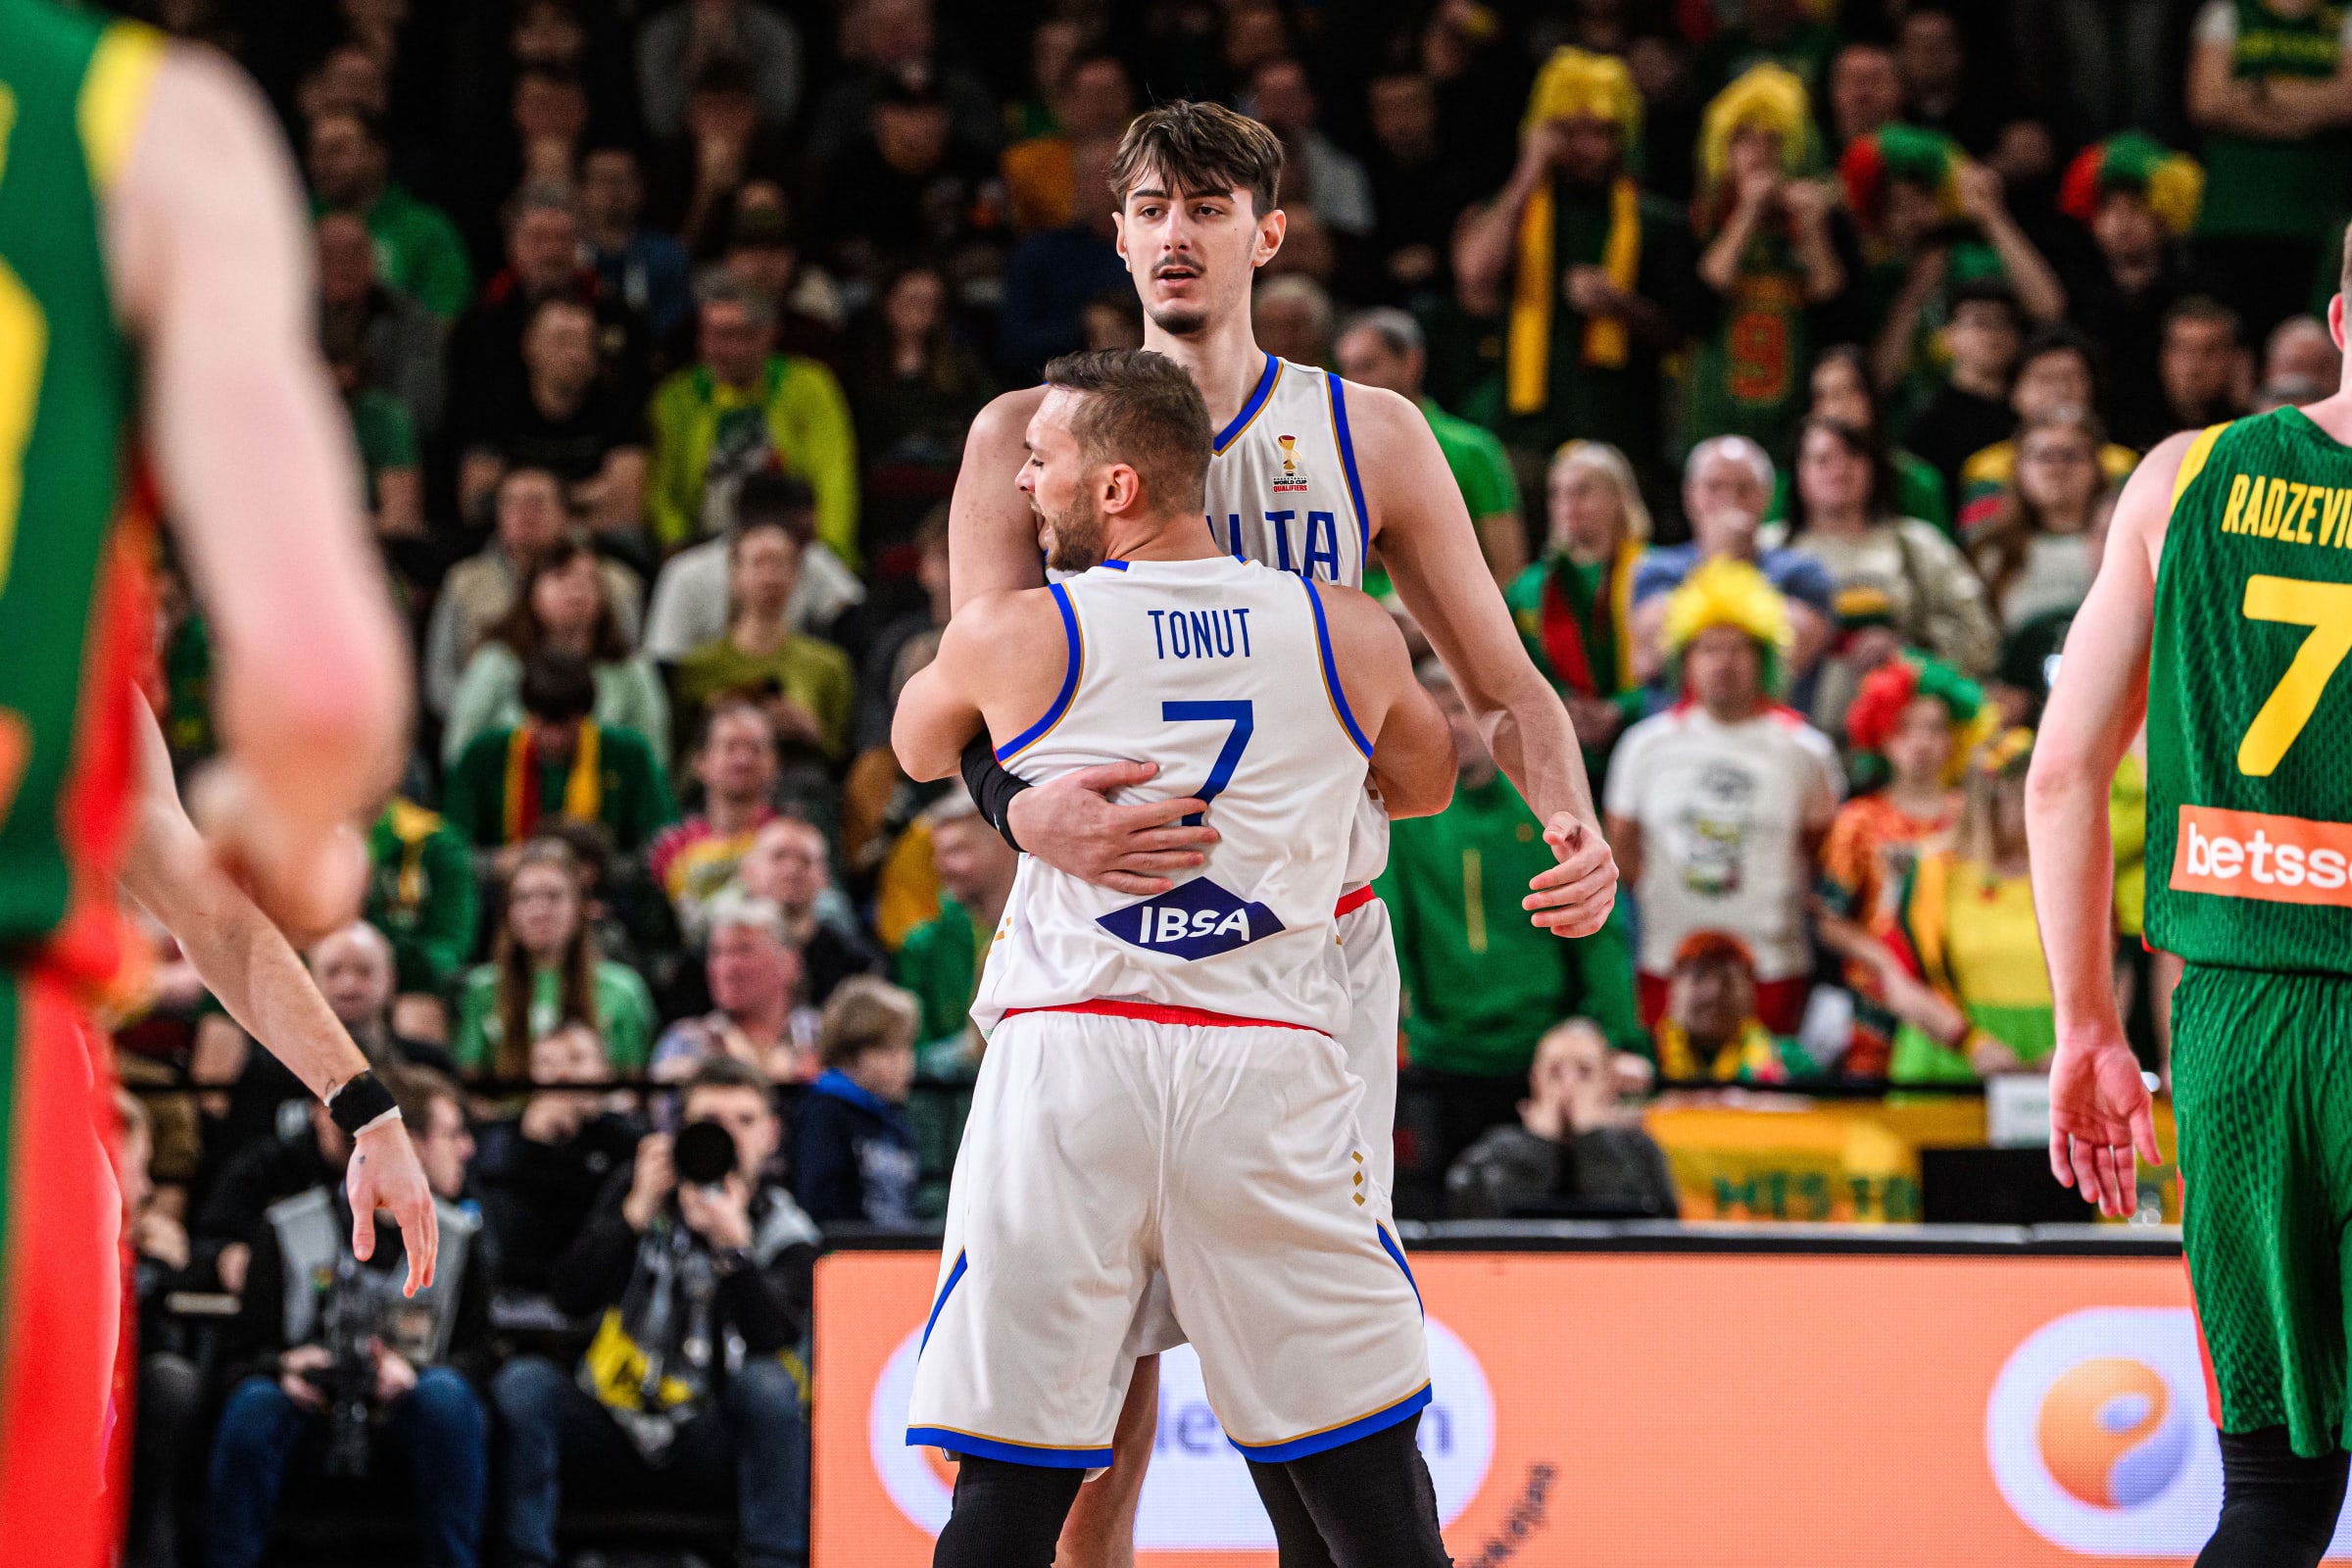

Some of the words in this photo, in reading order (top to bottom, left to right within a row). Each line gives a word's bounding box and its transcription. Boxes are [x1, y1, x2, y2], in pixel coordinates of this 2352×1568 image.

[1732, 311, 1790, 402] 9
[2222, 473, 2352, 550] RADZEVI
[1148, 608, 1250, 659] TONUT
[2237, 573, 2352, 777] 7
[1161, 700, 1253, 826] 7
[2186, 821, 2352, 890] betss
[1139, 906, 1250, 944] IBSA
